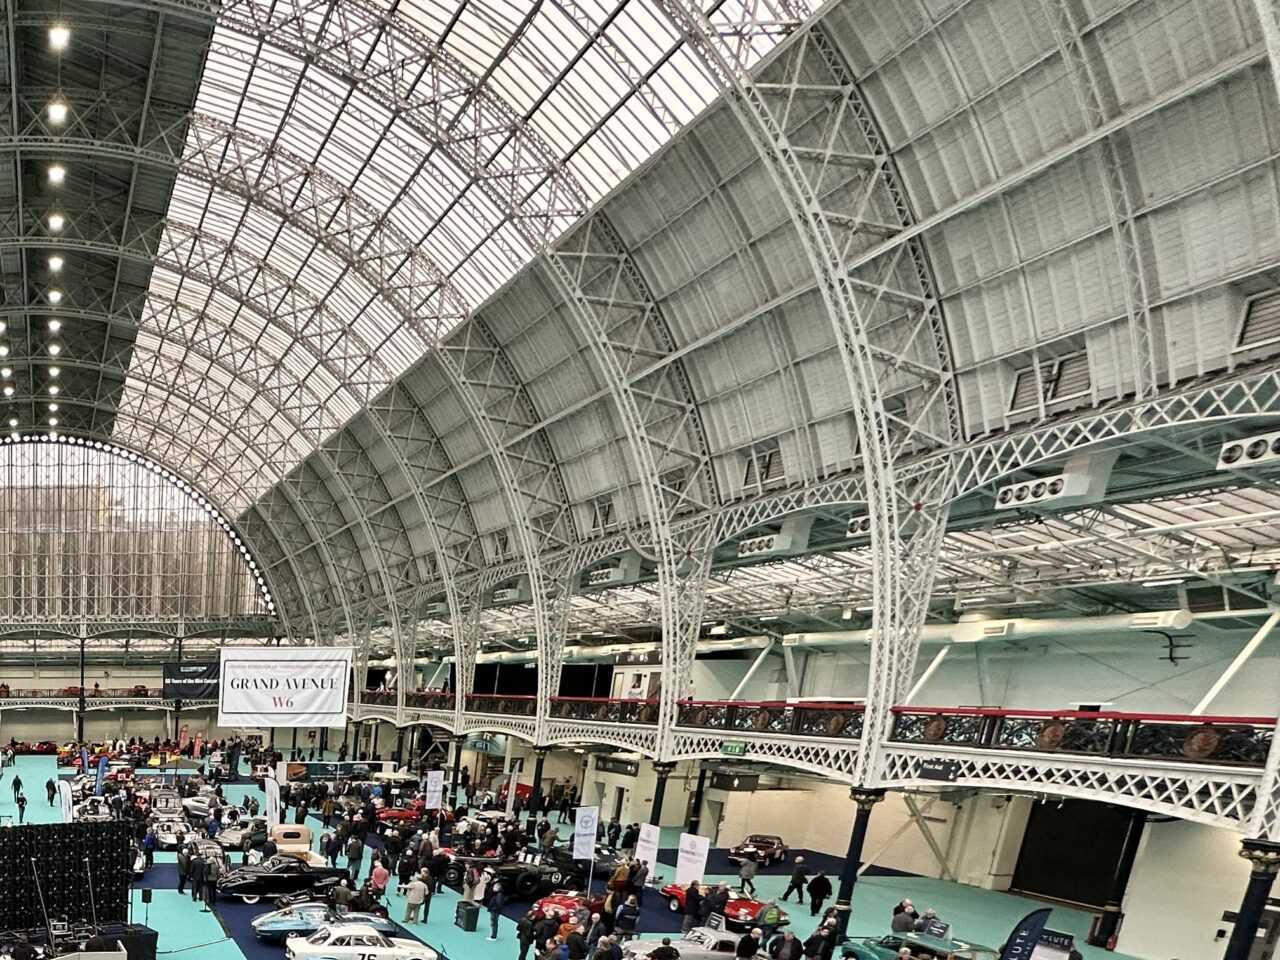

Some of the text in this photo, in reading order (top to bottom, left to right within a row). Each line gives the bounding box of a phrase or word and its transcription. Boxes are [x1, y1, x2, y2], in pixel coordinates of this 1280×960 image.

[230, 678, 338, 690] GRAND AVENUE
[272, 696, 294, 708] W6
